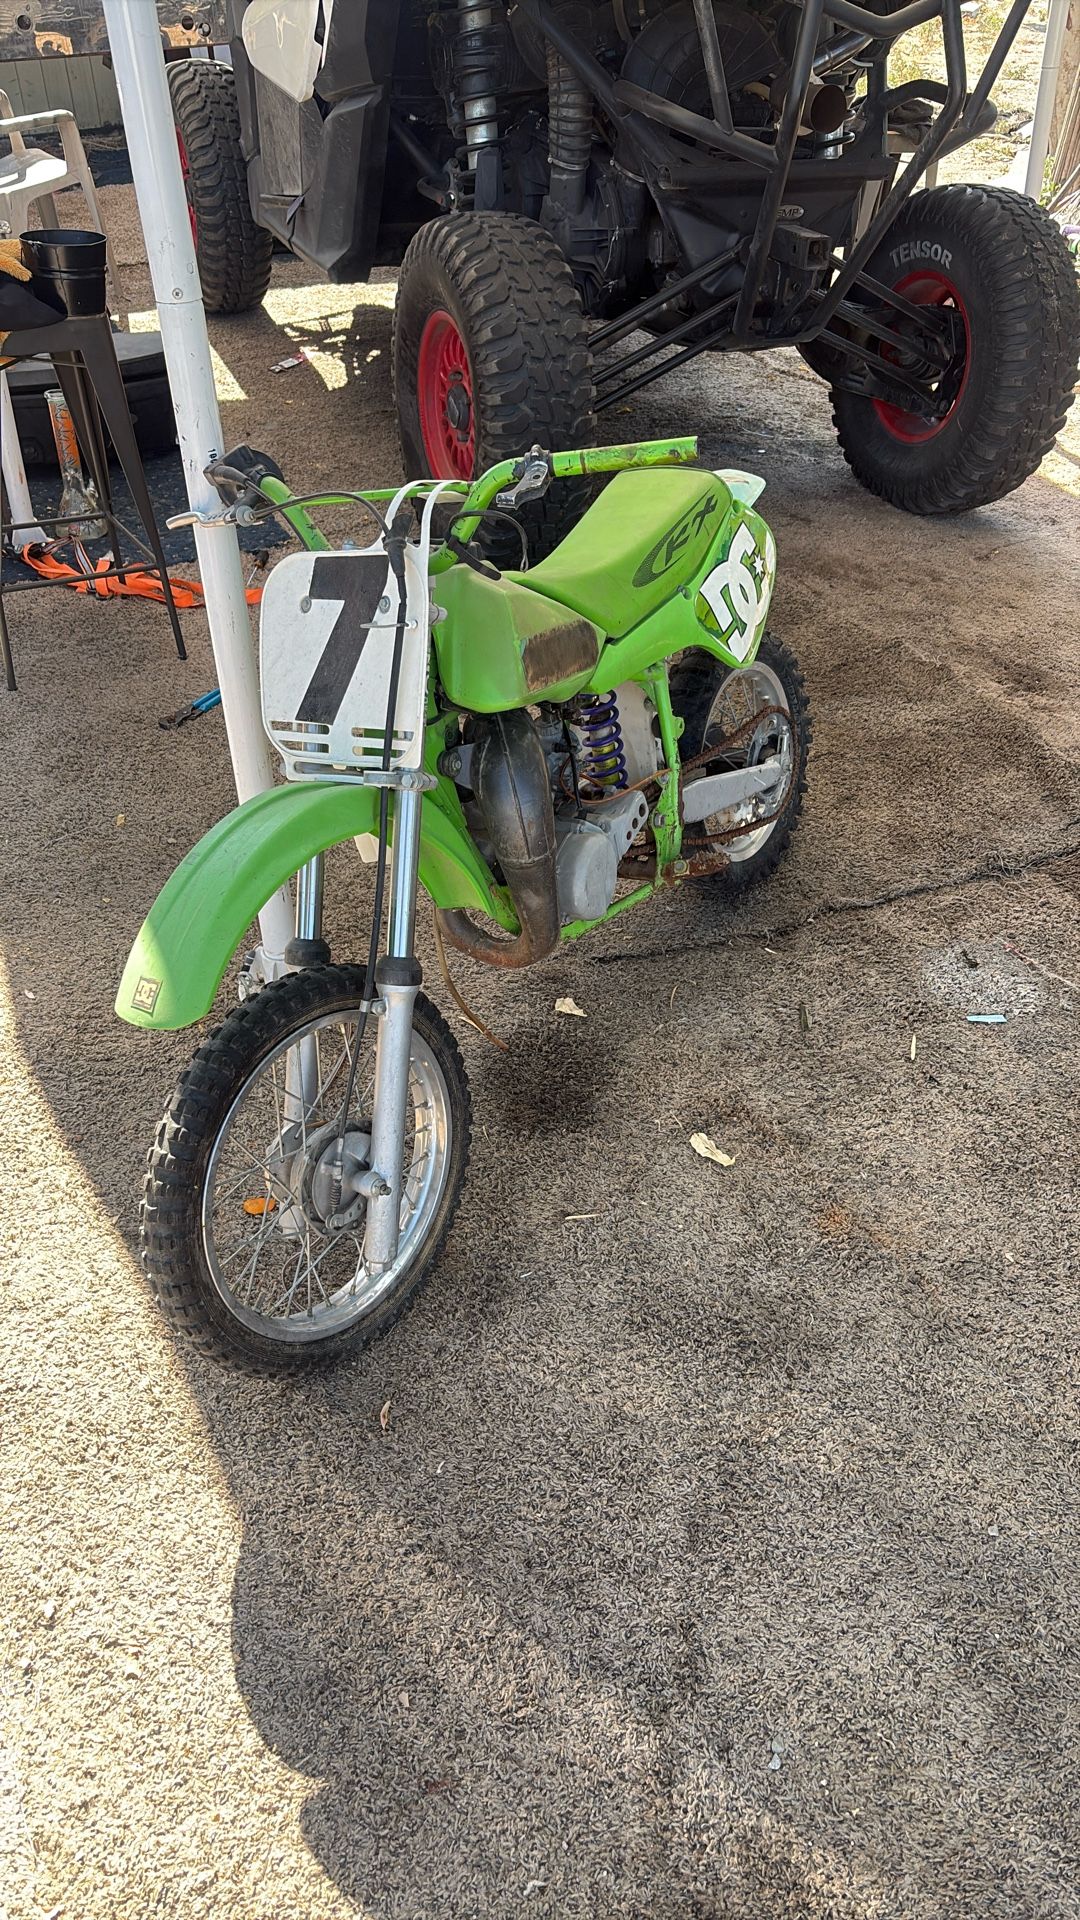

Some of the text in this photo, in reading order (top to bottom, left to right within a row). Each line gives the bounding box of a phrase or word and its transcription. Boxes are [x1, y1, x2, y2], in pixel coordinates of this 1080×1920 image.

[889, 240, 953, 270] TENSOR
[663, 494, 719, 567] KX
[295, 555, 390, 726] 7
[699, 521, 775, 664] DC
